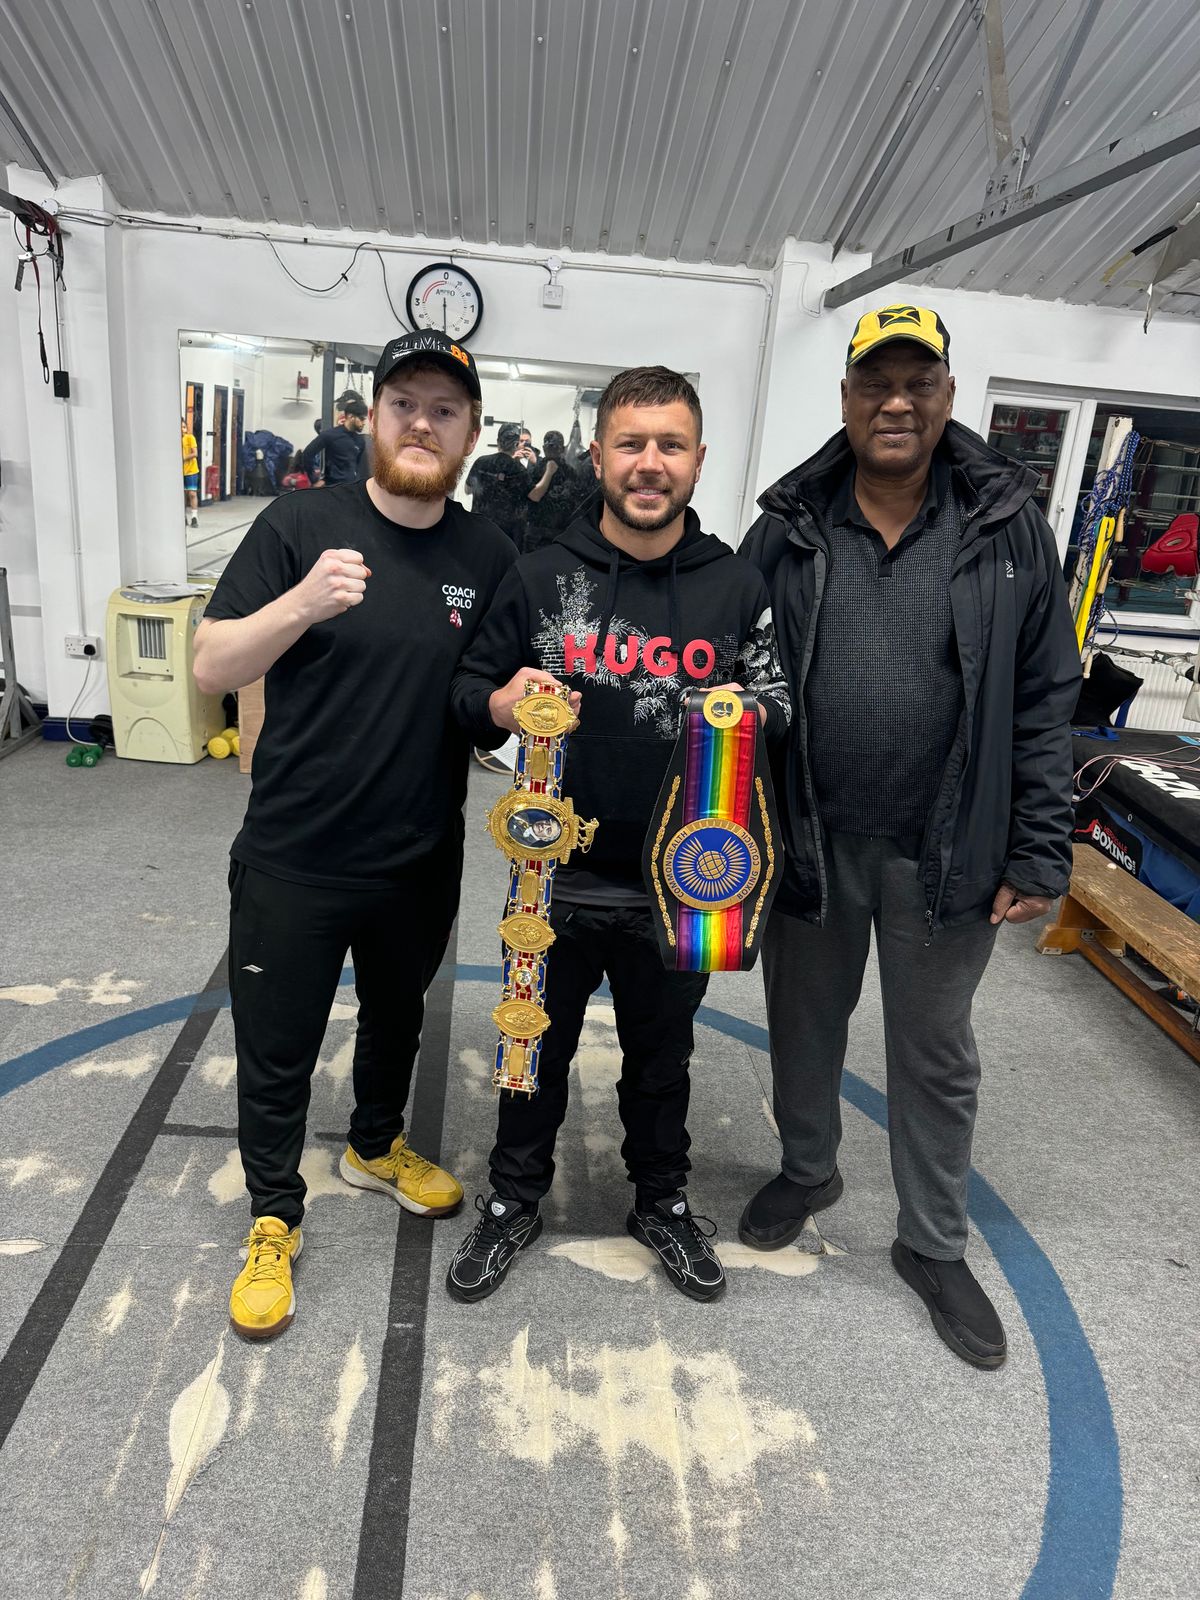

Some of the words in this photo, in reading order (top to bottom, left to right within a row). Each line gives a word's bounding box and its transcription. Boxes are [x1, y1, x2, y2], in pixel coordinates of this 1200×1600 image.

[443, 272, 449, 280] 0
[415, 298, 420, 306] 3
[470, 304, 474, 313] 1
[441, 584, 476, 600] COACH
[446, 595, 472, 610] SOLO
[564, 633, 716, 680] HUGO
[741, 831, 760, 866] COUNCIL
[1092, 824, 1133, 871] BOXING
[664, 830, 689, 898] COMMONWEALTH
[736, 870, 759, 900] BOXING
